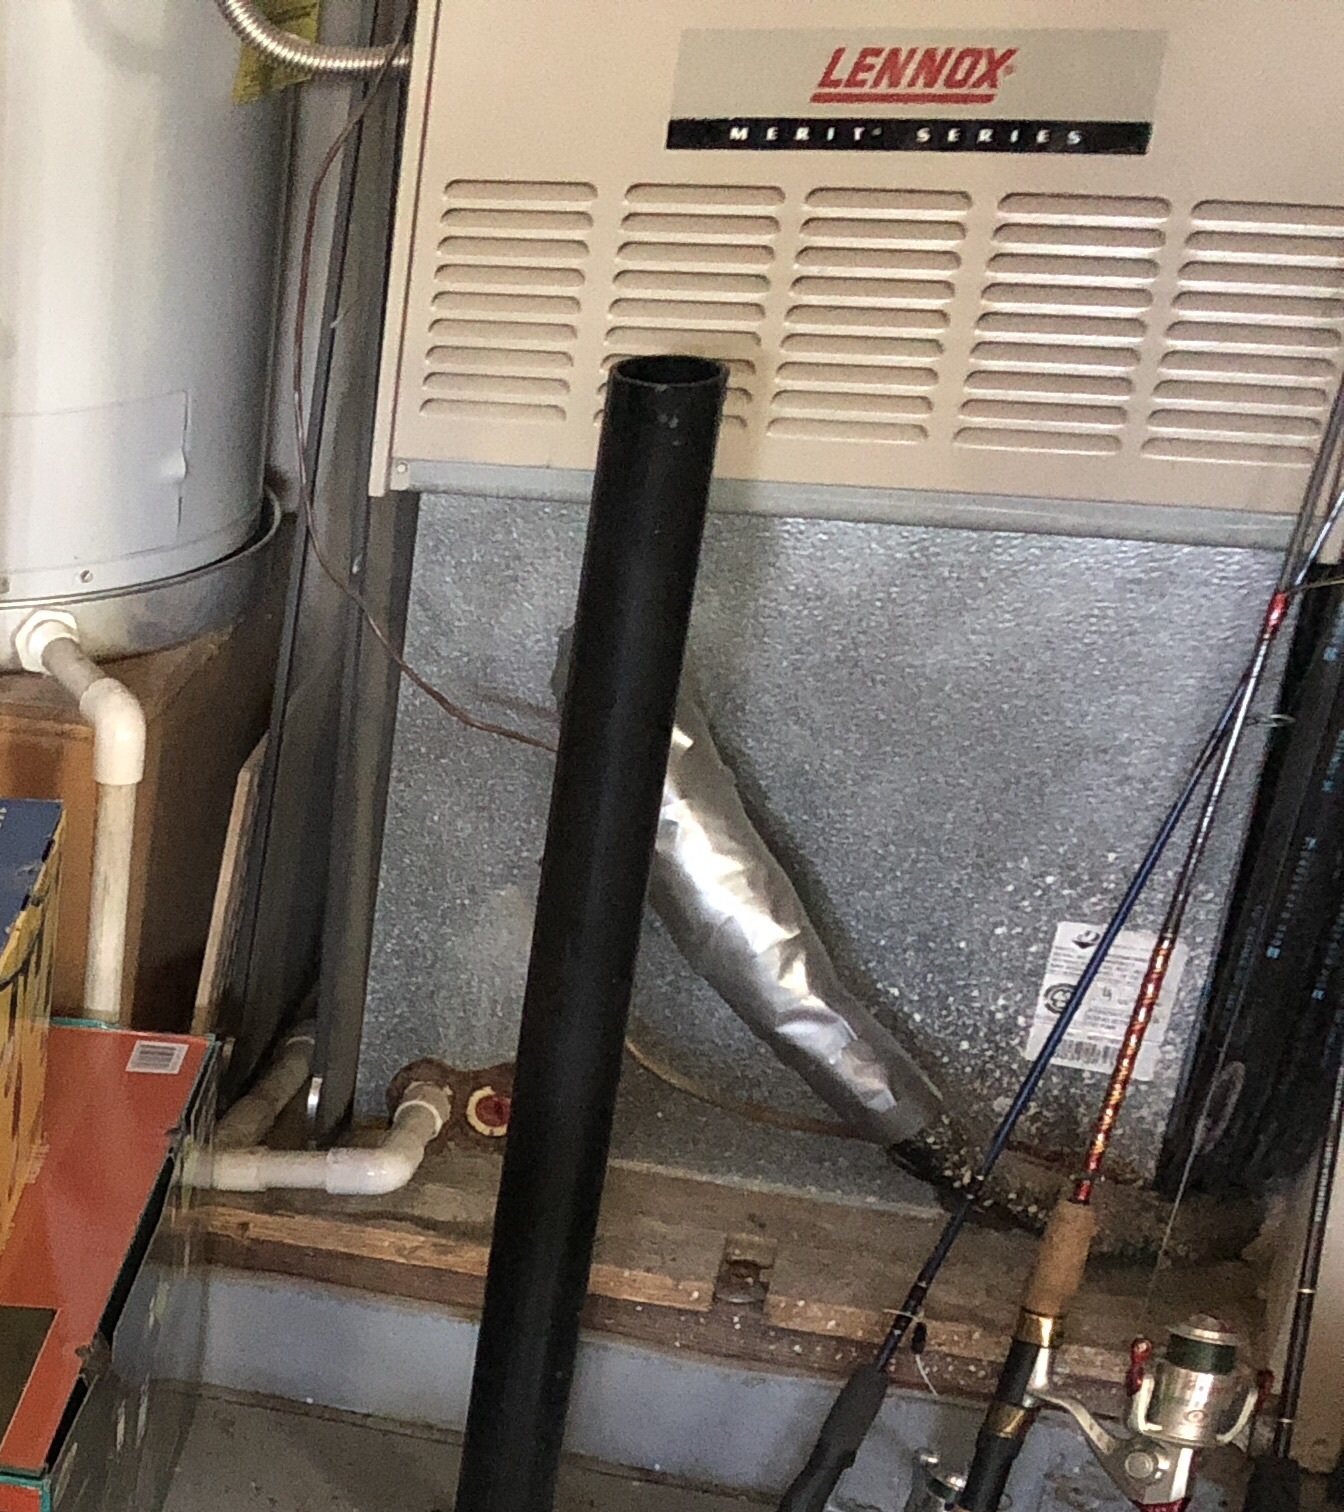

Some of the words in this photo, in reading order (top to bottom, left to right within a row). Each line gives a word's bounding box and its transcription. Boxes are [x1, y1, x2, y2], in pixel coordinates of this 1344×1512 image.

[816, 46, 1020, 91] LENNOX
[728, 126, 867, 142] MERIT
[915, 128, 1083, 145] SERIES
